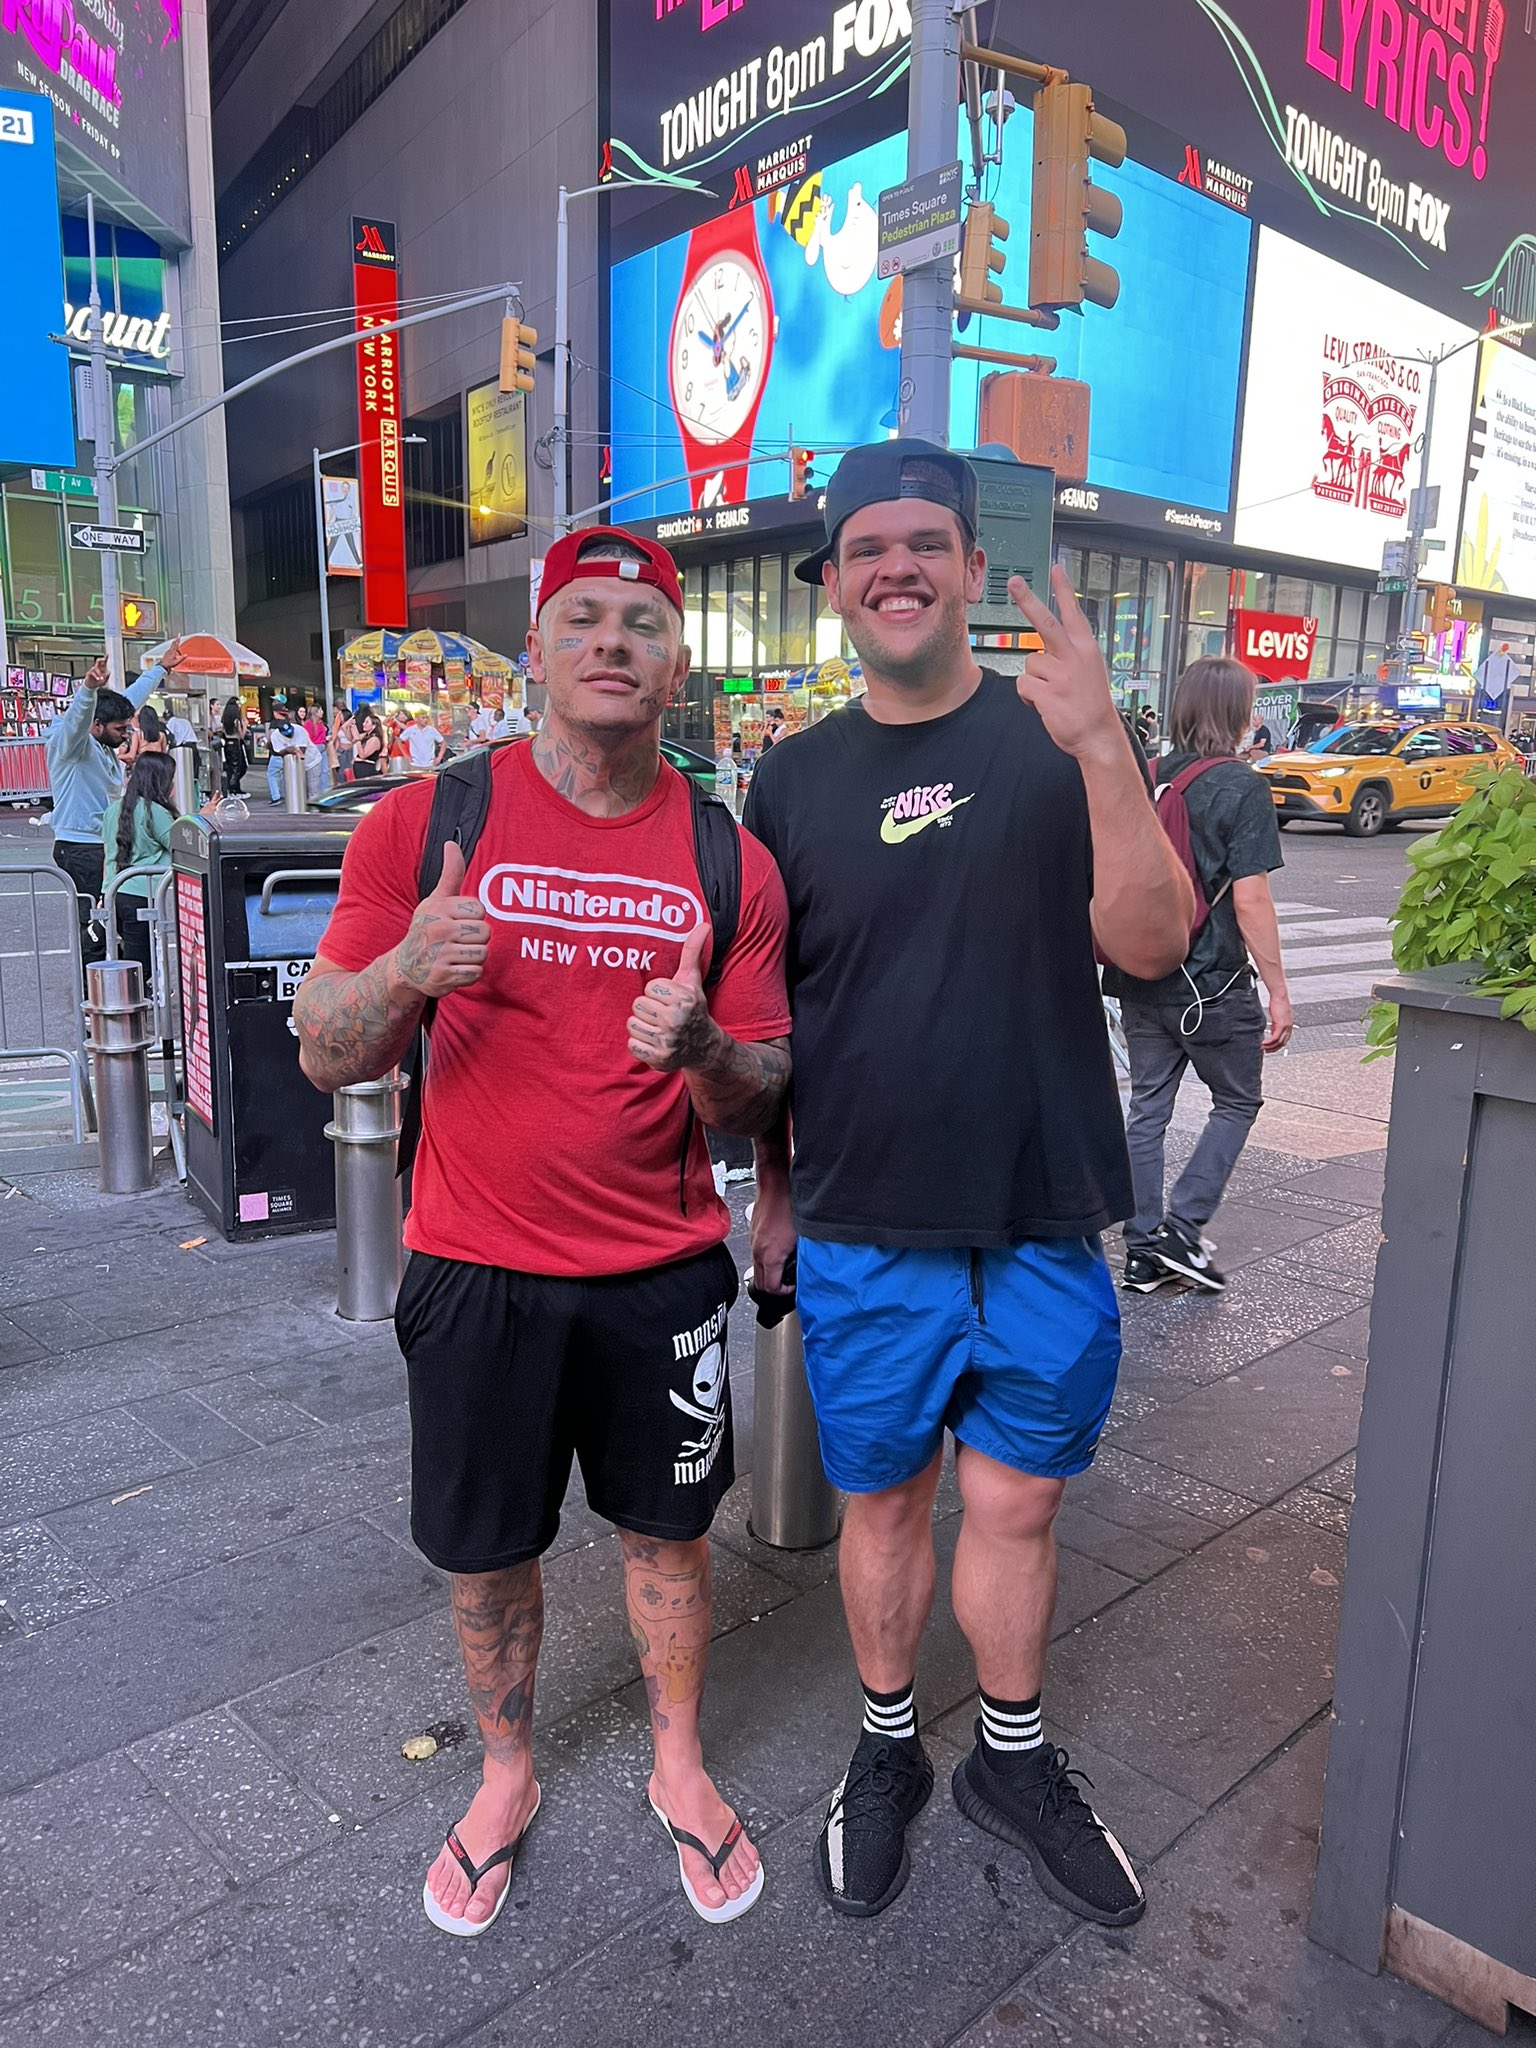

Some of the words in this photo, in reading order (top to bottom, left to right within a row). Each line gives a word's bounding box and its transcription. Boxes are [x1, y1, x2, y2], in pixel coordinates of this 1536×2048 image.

[60, 57, 92, 103] DRAG
[91, 87, 120, 130] RACE
[660, 57, 762, 167] TONIGHT
[766, 35, 826, 116] 8pm
[832, 0, 912, 75] FOX
[17, 59, 37, 87] NEW
[39, 79, 71, 118] SEASON
[81, 117, 109, 151] FRIDAY
[2, 115, 27, 136] 21
[757, 134, 813, 174] MARRIOTT
[757, 157, 806, 191] MARQUIS
[1206, 158, 1254, 194] MARRIOTT
[1285, 104, 1368, 203] TONIGHT
[1366, 158, 1406, 227] 8pm
[1406, 181, 1451, 252] FOX
[1205, 176, 1248, 209] MARQUIS
[881, 219, 929, 244] Pedestrian
[931, 208, 956, 227] Plaza
[882, 206, 910, 227] Times
[912, 193, 948, 216] Square
[362, 250, 395, 262] MARRIOTT
[363, 316, 376, 357] NW
[1324, 334, 1348, 366] LEVI
[1353, 342, 1397, 382] STRAUSS
[1397, 365, 1404, 388] &
[1406, 368, 1421, 394] CO.
[364, 364, 378, 412] YORK
[1324, 380, 1369, 418] ORIGINAL
[1372, 398, 1413, 428] RIVETED
[1377, 421, 1401, 440] CLOTHING
[383, 422, 398, 505] MARQUIS
[59, 476, 65, 490] 7
[71, 477, 81, 487] Av
[1060, 487, 1099, 511] PEANUTS
[1317, 487, 1349, 502] PATENTED
[81, 532, 103, 542] ONE
[113, 535, 135, 545] WAY
[657, 516, 695, 539] swatch
[716, 508, 749, 530] PEANUTS
[1392, 582, 1401, 590] 45
[501, 877, 686, 927] Nintendo
[520, 937, 577, 966] NEW
[587, 945, 657, 971] YORK
[270, 1201, 293, 1209] SQUARE
